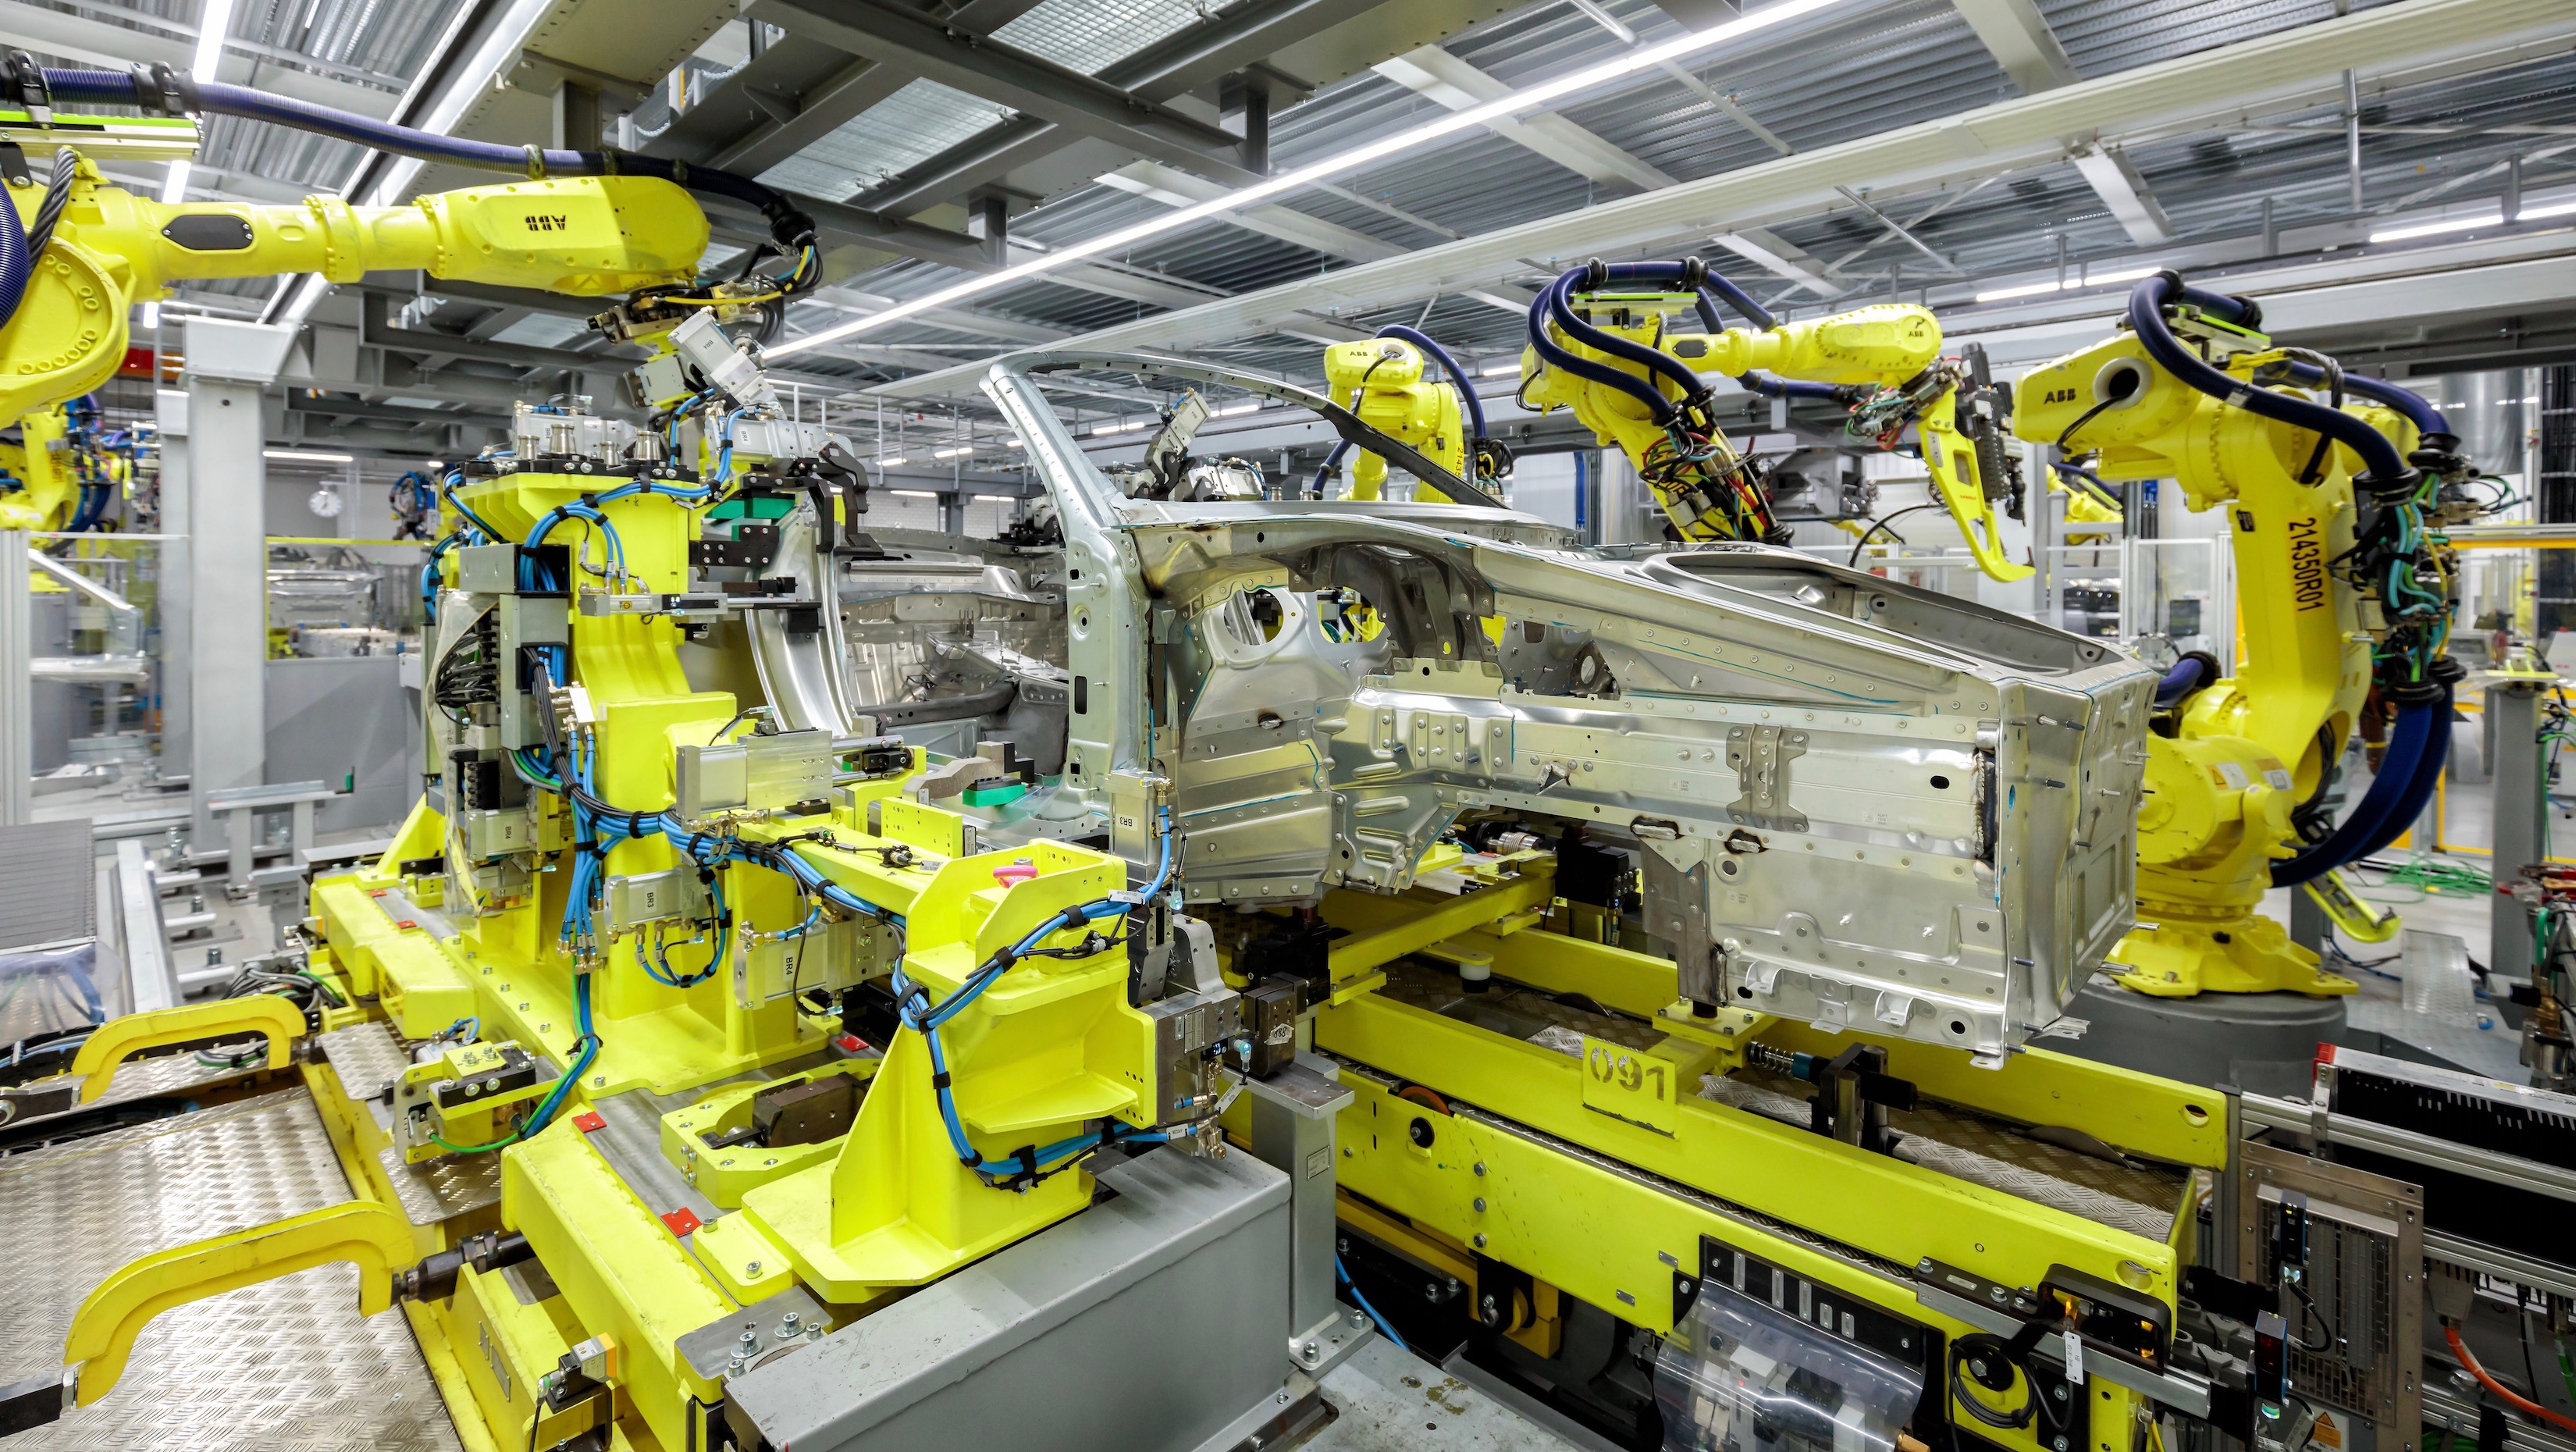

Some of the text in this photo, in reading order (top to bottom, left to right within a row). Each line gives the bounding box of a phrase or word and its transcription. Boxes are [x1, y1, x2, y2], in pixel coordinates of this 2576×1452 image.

[525, 215, 566, 231] ABB
[703, 340, 713, 350] BR4
[2044, 388, 2076, 404] ABB
[2288, 518, 2325, 611] 214350R01
[1119, 817, 1133, 827] BR3
[1590, 1047, 1664, 1101] 091
